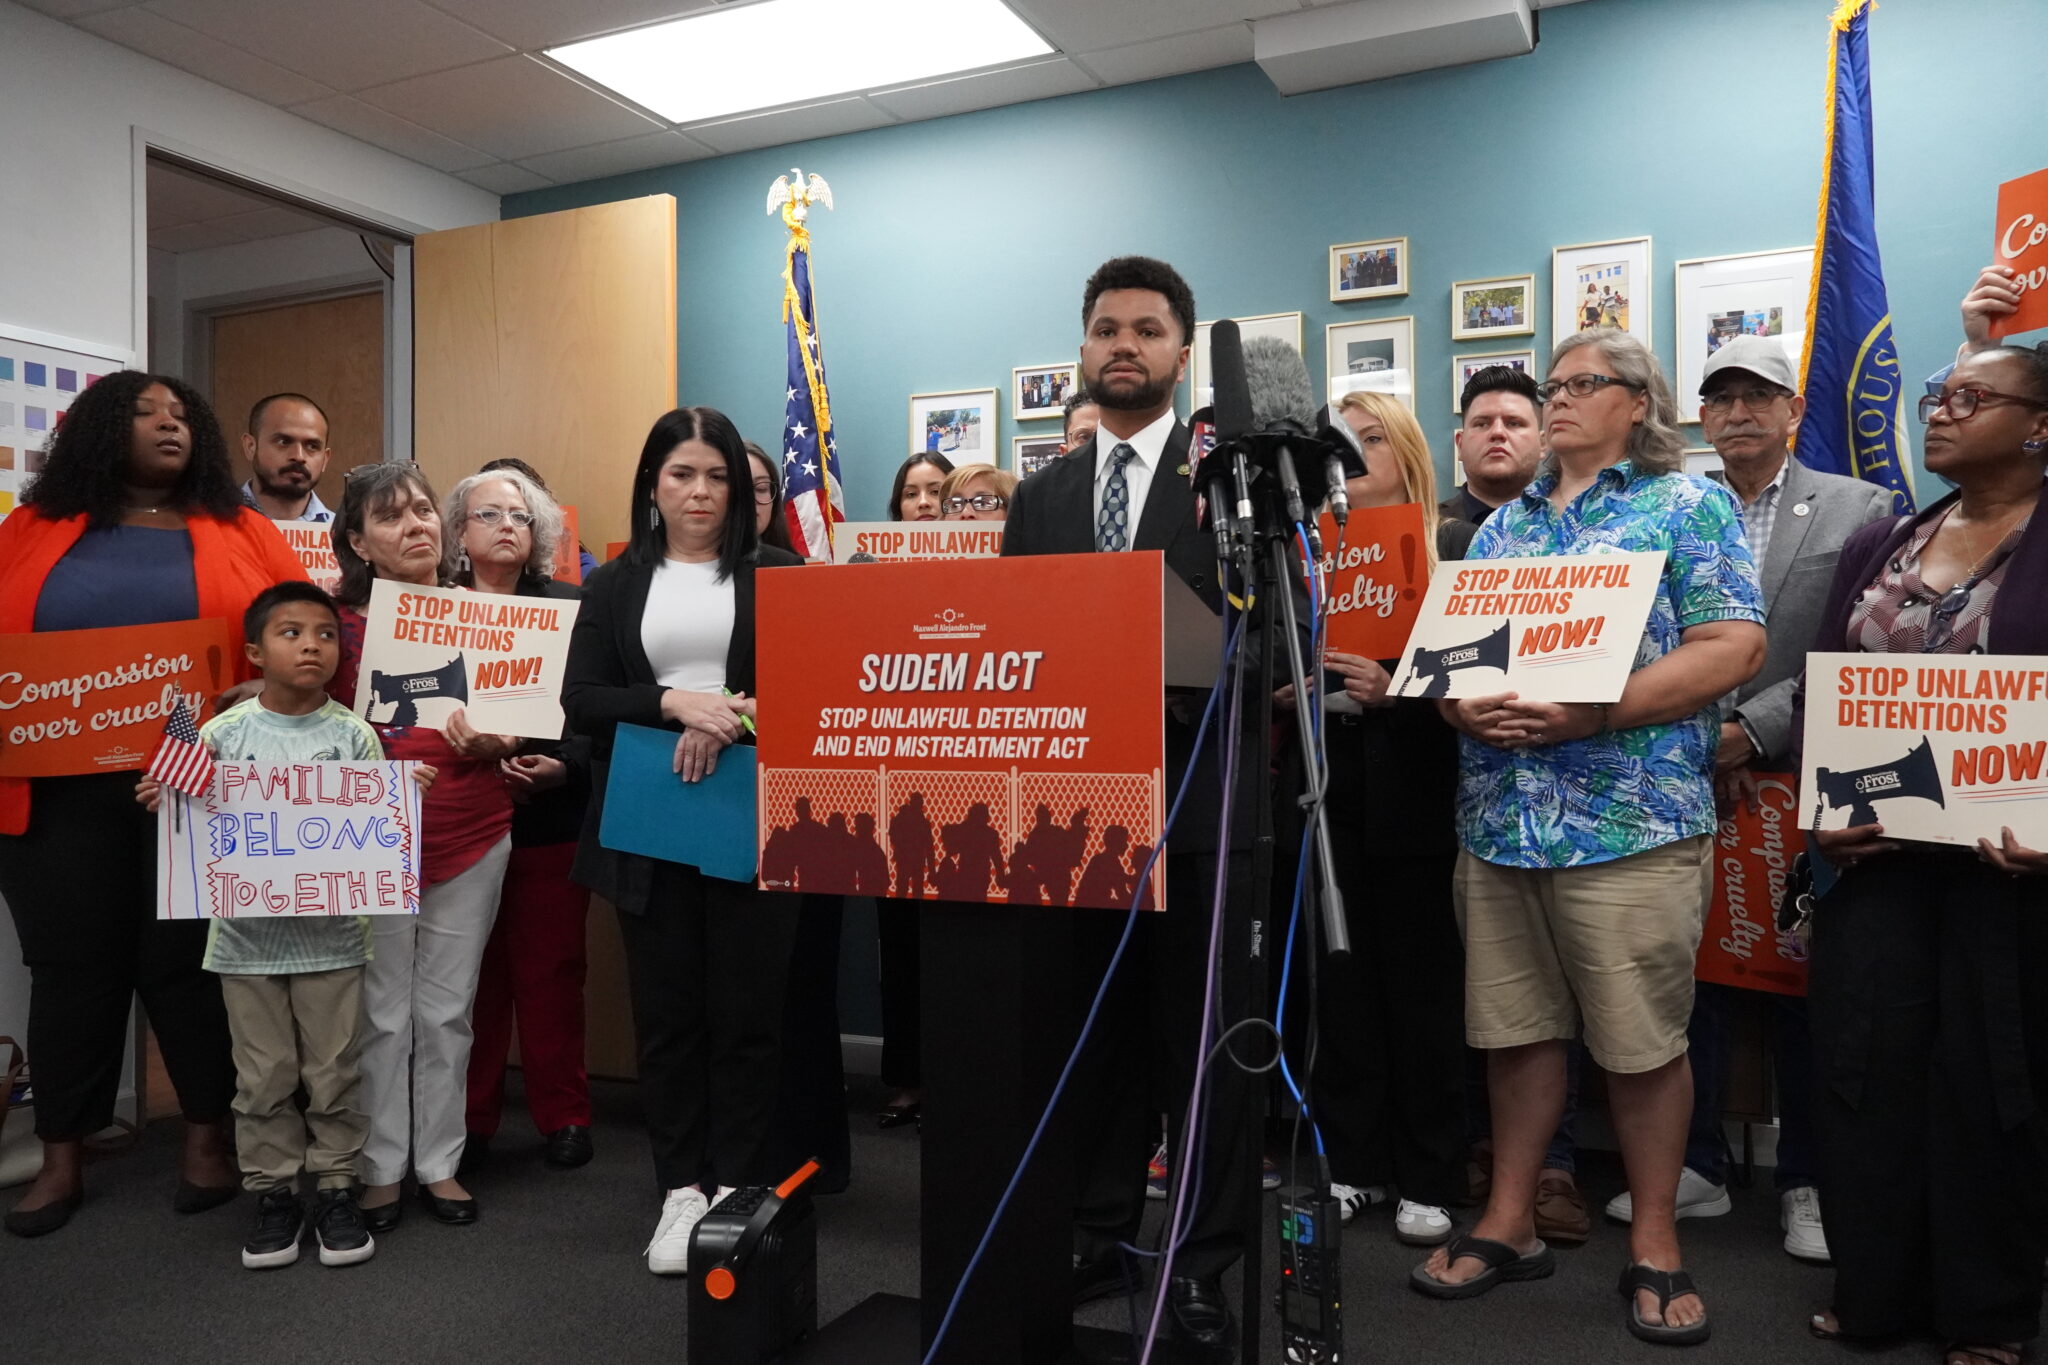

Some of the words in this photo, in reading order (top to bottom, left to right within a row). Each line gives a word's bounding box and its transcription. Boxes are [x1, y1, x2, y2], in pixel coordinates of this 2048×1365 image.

[1857, 335, 1902, 474] HOUS
[282, 529, 330, 549] UNLA
[856, 532, 904, 554] STOP
[909, 531, 1003, 554] UNLAWFU
[1453, 568, 1509, 592] STOP
[1512, 564, 1631, 590] UNLAWFUL
[397, 592, 454, 621] STOP
[458, 600, 560, 632] UNLAWFUL
[1444, 591, 1573, 616] DETENTIONS
[393, 617, 515, 653] DETENTIONS
[913, 624, 938, 633] Maxwell
[939, 623, 969, 633] Alejandro
[970, 623, 987, 631] Frost
[1517, 615, 1605, 657] NOW!
[858, 652, 969, 693] SUDEM
[973, 650, 1043, 692] ACT
[1449, 647, 1479, 662] Frost
[0, 653, 193, 710] Compassion
[409, 677, 439, 690] Frost
[474, 656, 542, 690] NOW!
[1837, 666, 1909, 696] STOP
[9, 717, 82, 745] over
[818, 707, 867, 729] STOP
[870, 707, 972, 729] UNLAWFUL
[976, 706, 1087, 730] DETENTION
[1837, 698, 2008, 735] DETENTIONS
[812, 735, 851, 757] AND
[854, 735, 891, 757] END
[894, 735, 1044, 759] MISTREATMENT
[1046, 736, 1090, 759] ACT
[1951, 740, 2048, 787] NOW
[222, 764, 385, 806] FAMILIES
[1862, 770, 1900, 788] Frost
[219, 811, 401, 857] BELONG
[214, 870, 420, 918] TOGETHER
[1719, 857, 1766, 960] cruelty
